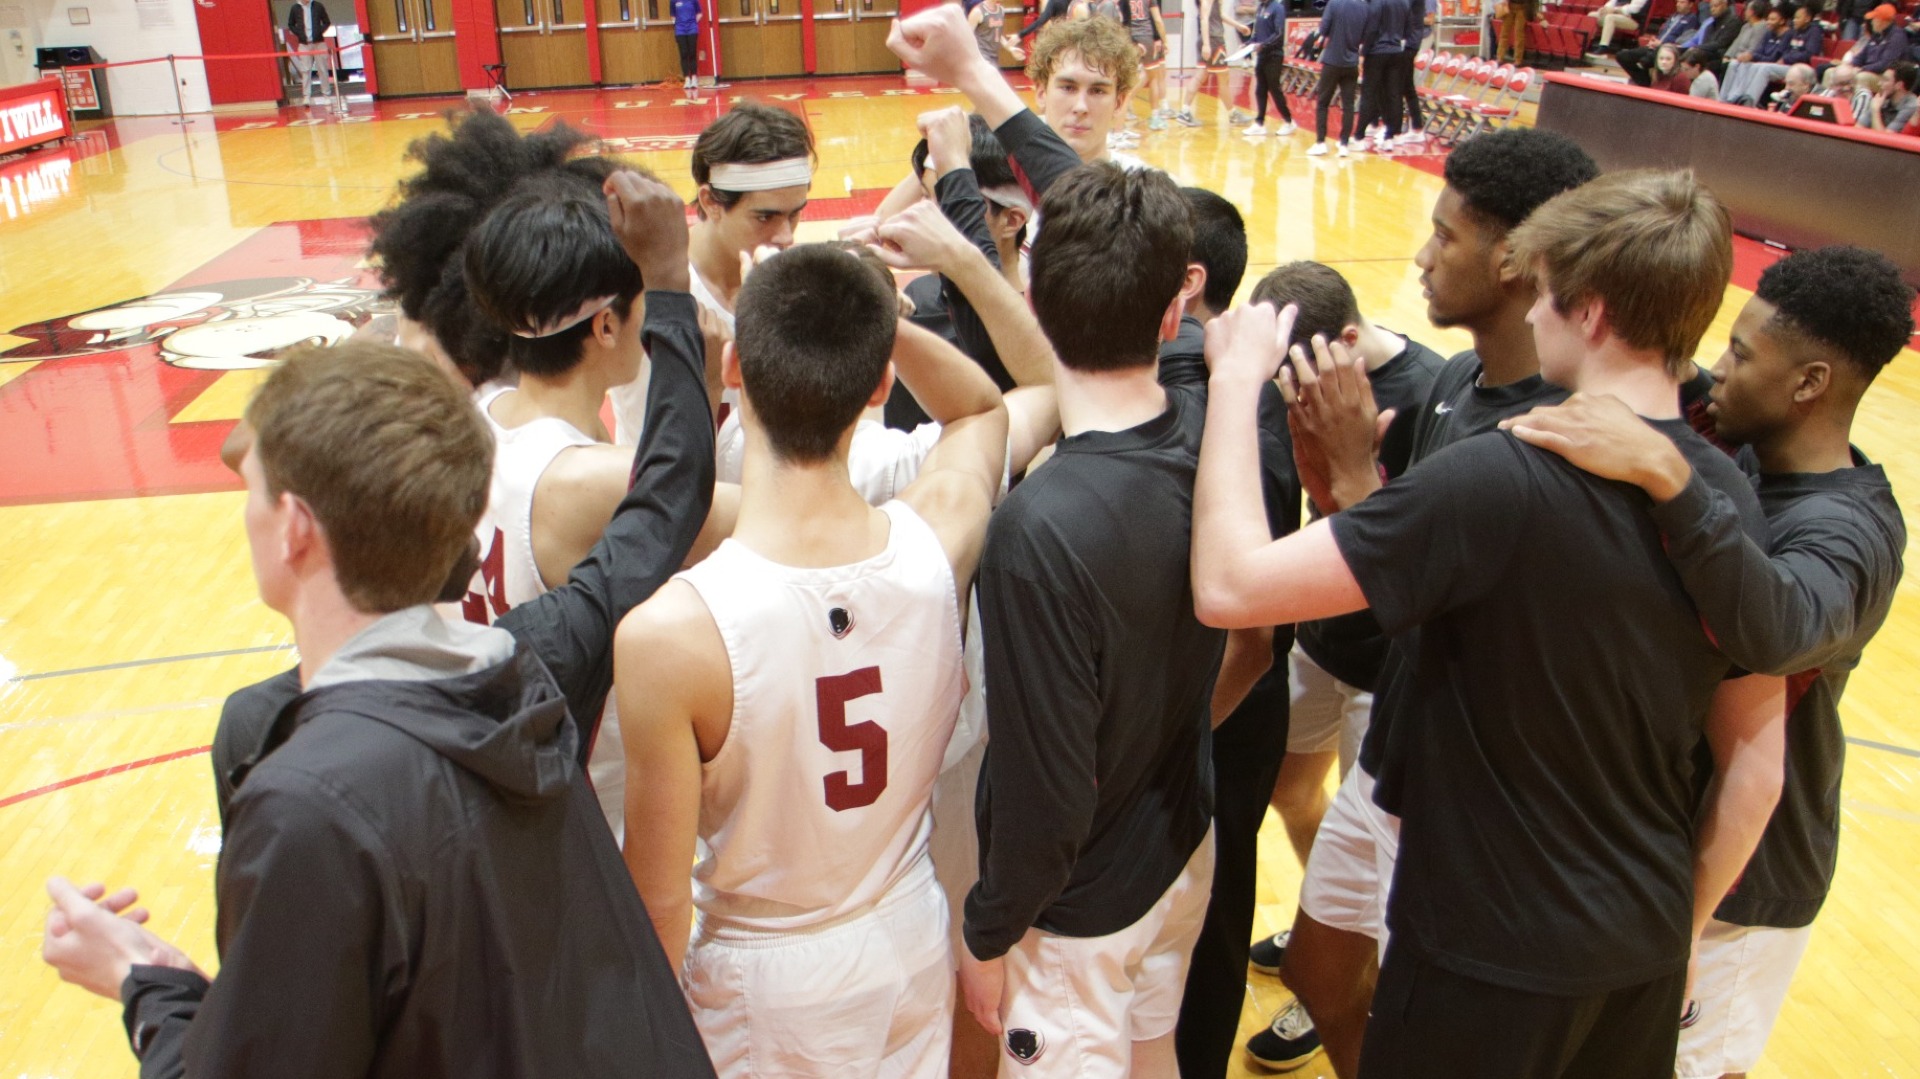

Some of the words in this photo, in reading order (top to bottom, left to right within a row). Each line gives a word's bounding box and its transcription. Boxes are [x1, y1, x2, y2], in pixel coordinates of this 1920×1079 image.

[8, 99, 63, 139] WILL
[231, 106, 549, 130] BOSTN
[462, 525, 511, 627] 4
[815, 665, 888, 812] 5
